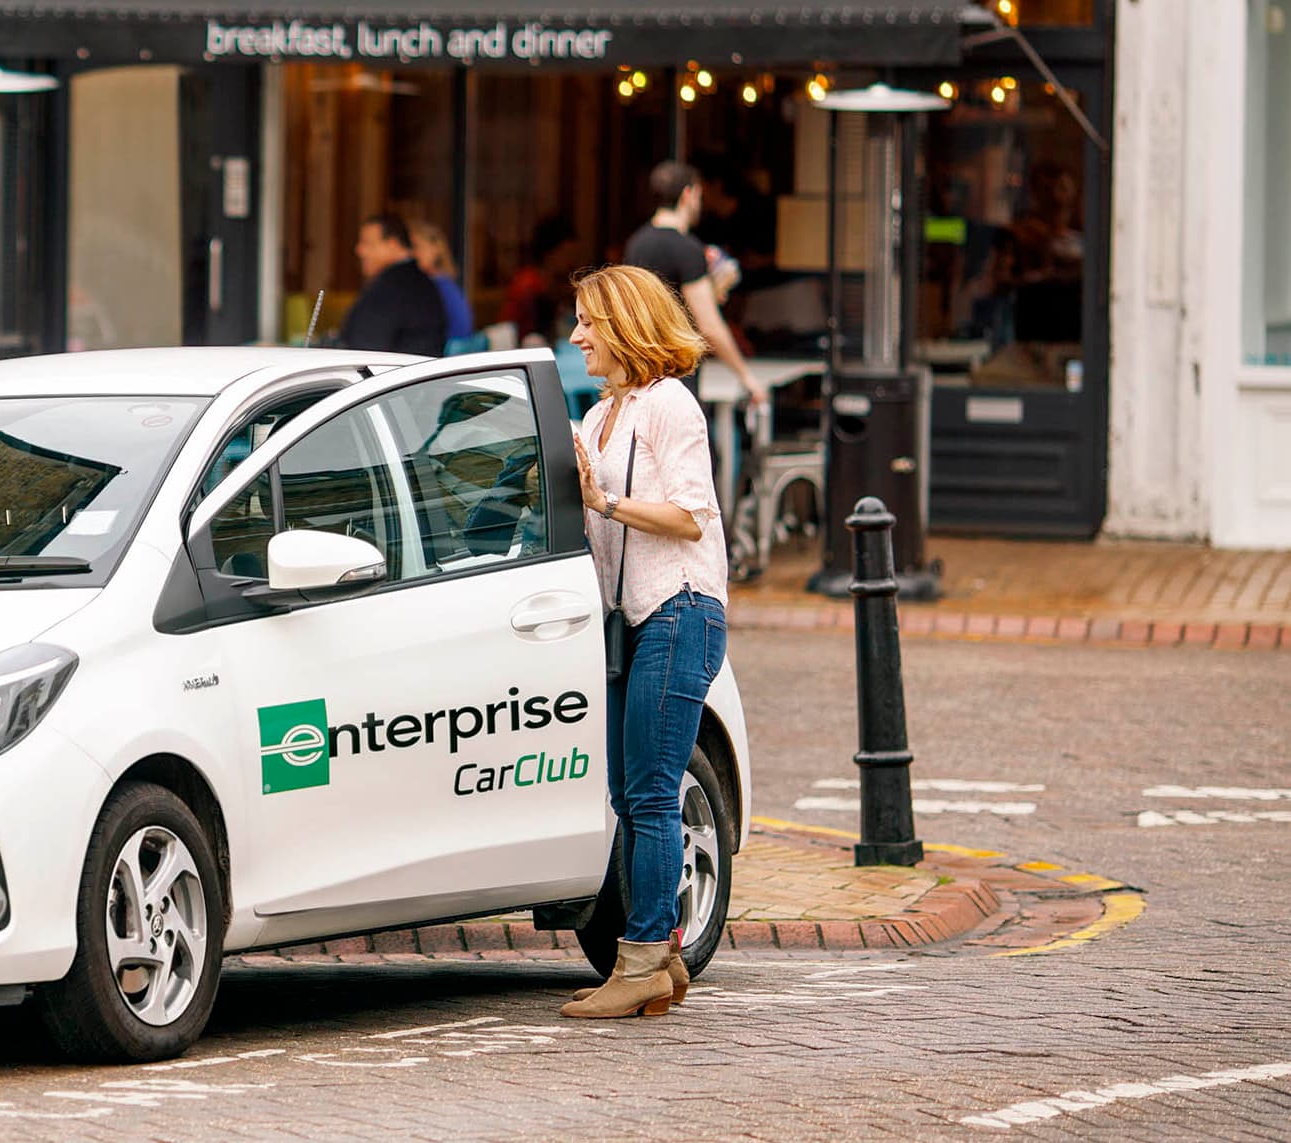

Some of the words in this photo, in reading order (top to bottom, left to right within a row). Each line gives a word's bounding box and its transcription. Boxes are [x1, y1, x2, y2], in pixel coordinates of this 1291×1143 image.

[208, 21, 352, 57] breakfast,
[357, 22, 443, 57] lunch
[446, 22, 508, 57] and
[511, 22, 611, 58] dinner
[259, 686, 590, 768] enterprise
[453, 747, 590, 797] CarClub
